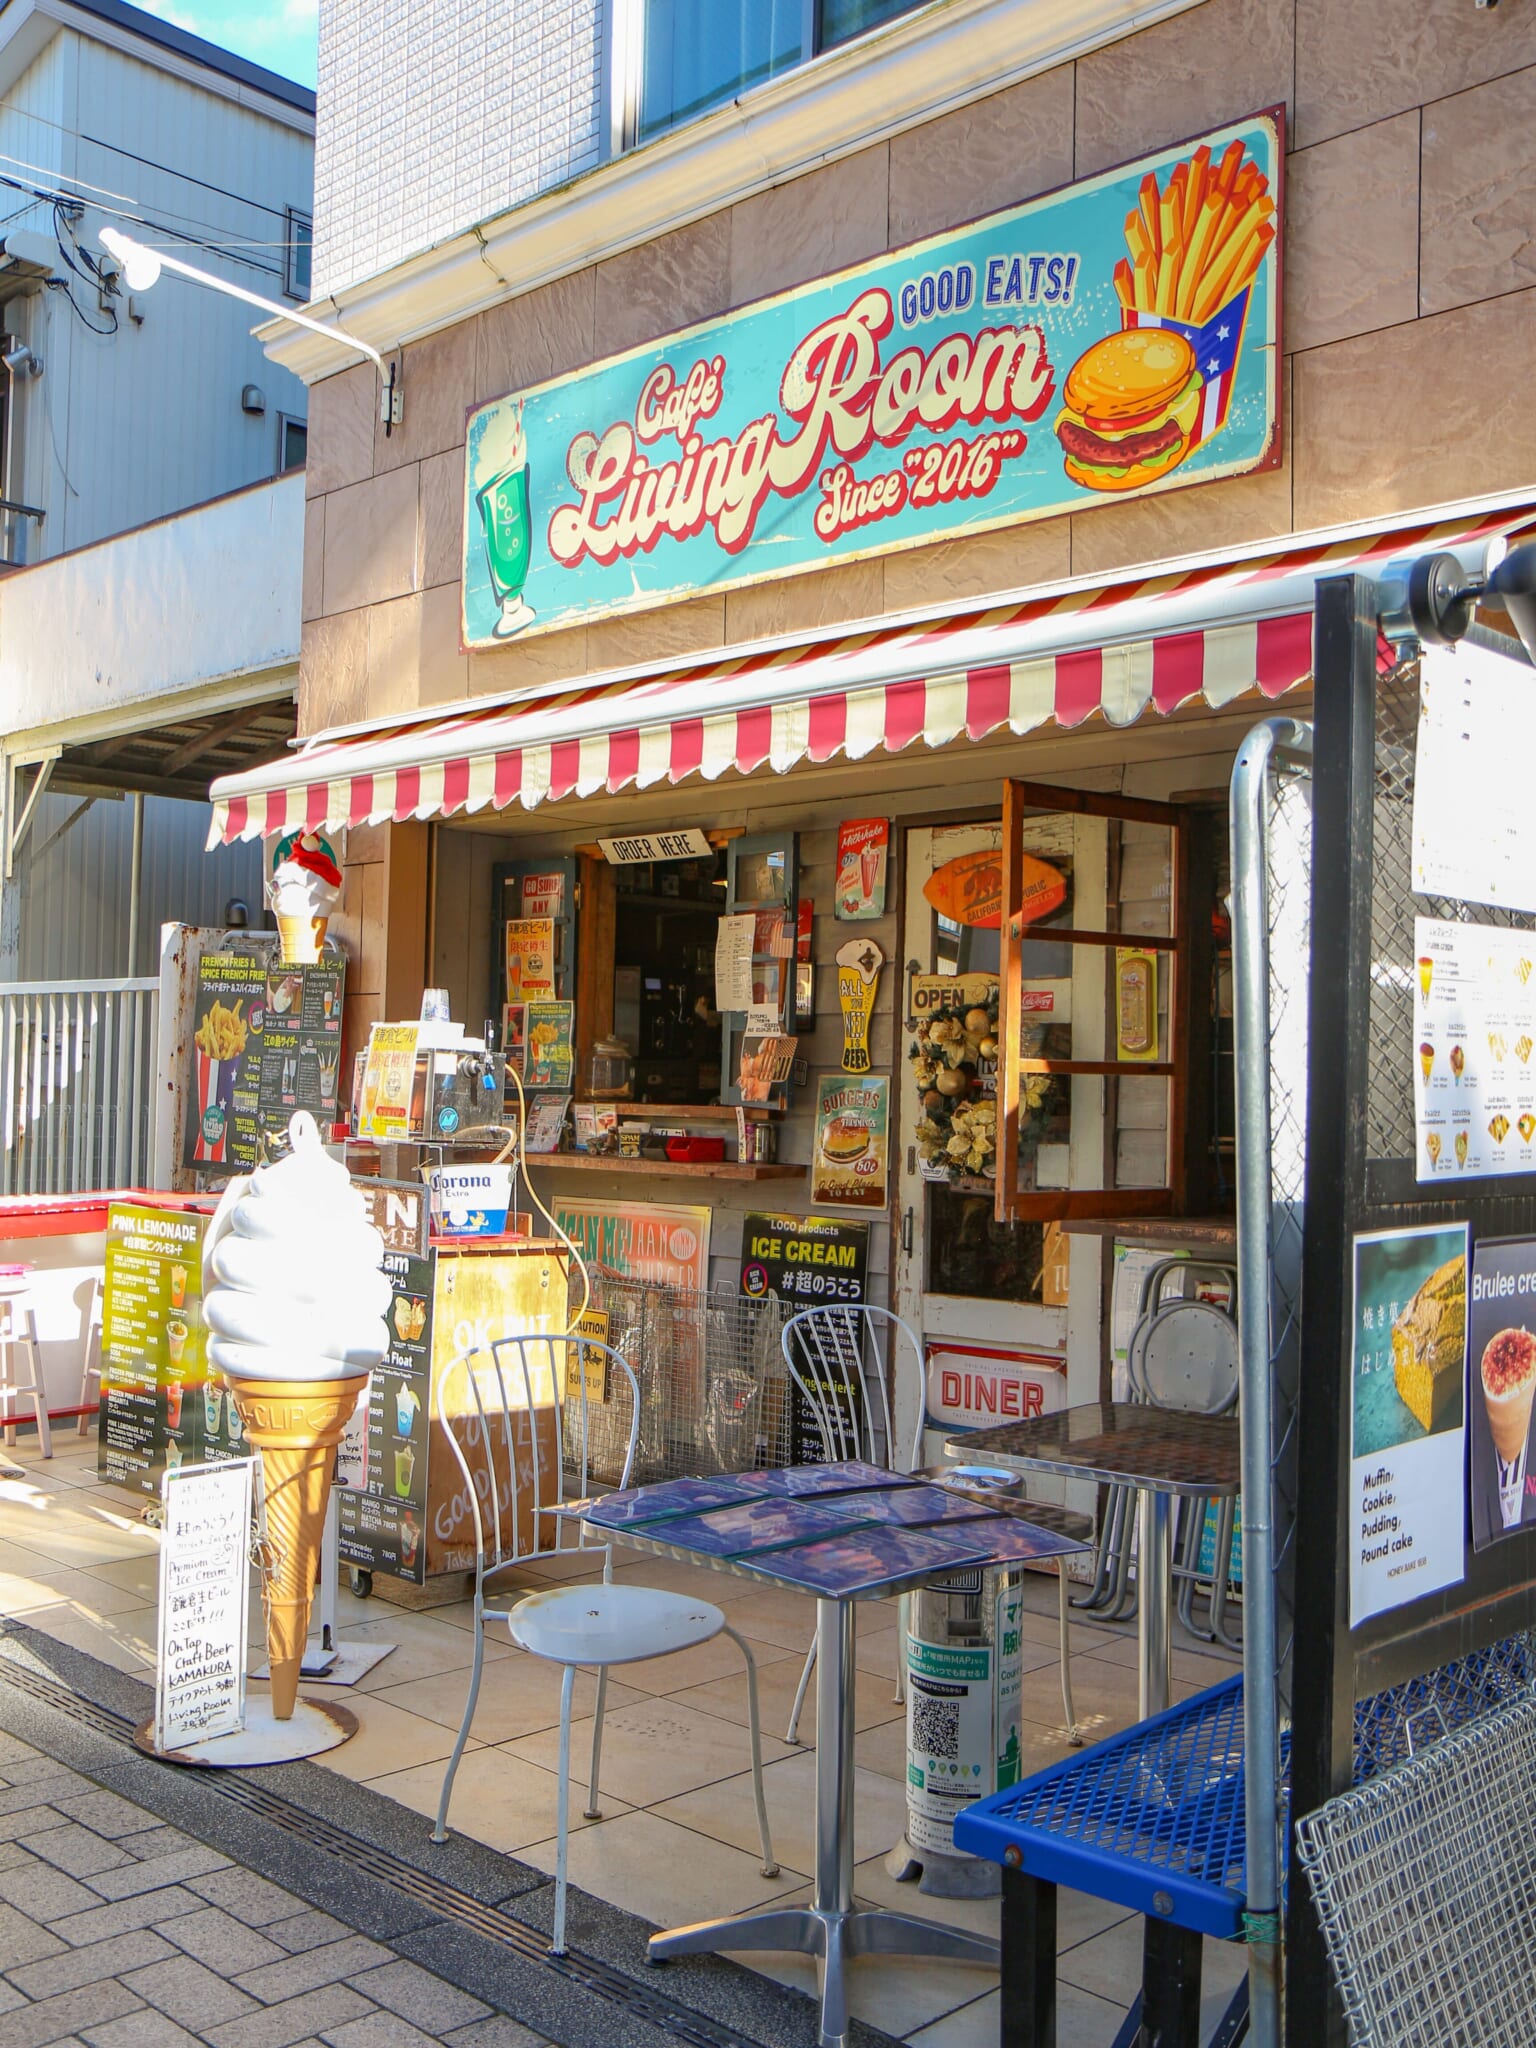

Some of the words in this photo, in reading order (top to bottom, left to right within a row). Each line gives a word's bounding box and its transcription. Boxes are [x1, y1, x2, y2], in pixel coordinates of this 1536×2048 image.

[901, 264, 973, 326] GOOD
[985, 257, 1078, 304] EATS!
[549, 414, 778, 567] Living
[768, 288, 1056, 496] Room
[815, 461, 909, 541] Since
[612, 838, 656, 860] ORDER
[657, 833, 696, 857] HERE
[525, 880, 537, 895] GO
[532, 900, 549, 913] ANY
[967, 900, 1002, 922] CALIFORN
[201, 956, 229, 968] FRENCH
[229, 957, 249, 968] FRIES
[840, 978, 864, 998] ALL
[914, 988, 965, 1009] OPEN
[842, 1048, 868, 1070] BEER
[822, 1089, 880, 1117] BURGERS
[430, 1174, 491, 1193] Corona
[446, 1189, 469, 1197] Extra
[112, 1214, 135, 1233] PINK
[137, 1218, 197, 1242] LEMONADE
[771, 1219, 796, 1232] LOCO
[798, 1223, 839, 1236] products
[751, 1236, 782, 1260] ICE
[786, 1240, 856, 1268] CREAM
[1473, 1270, 1515, 1301] Brulee
[453, 1318, 495, 1353] OK
[942, 1370, 1044, 1418] DINER
[1363, 1467, 1393, 1491] Muffin,
[1362, 1490, 1396, 1514] Cookie,
[1362, 1514, 1401, 1539] Pudding,
[1361, 1537, 1389, 1565] Pound
[1392, 1532, 1413, 1553] cake
[196, 1569, 226, 1581] Cream
[168, 1640, 183, 1657] On
[184, 1637, 202, 1655] Tap
[175, 1651, 203, 1670] Craft
[205, 1642, 234, 1660] Beer
[169, 1660, 232, 1688] KAMAKURA
[169, 1706, 202, 1726] Living
